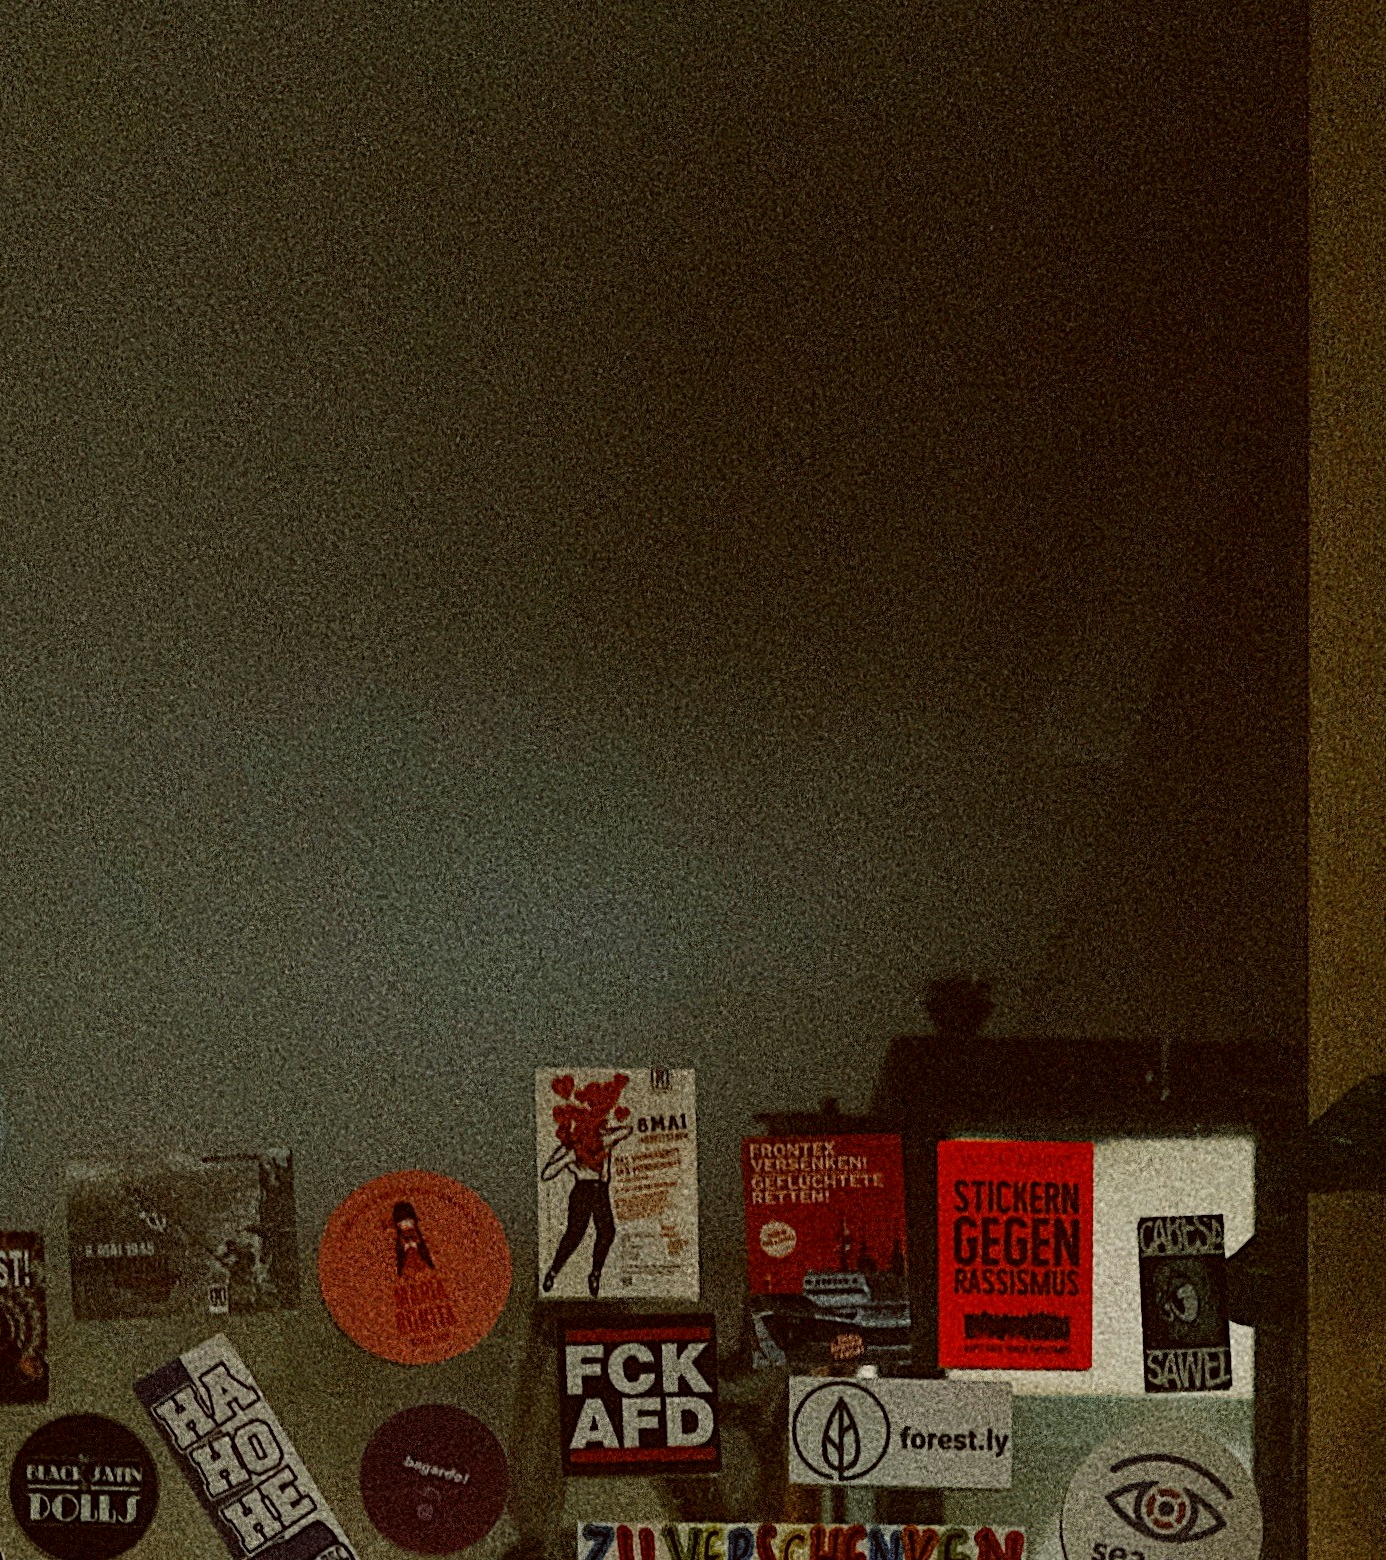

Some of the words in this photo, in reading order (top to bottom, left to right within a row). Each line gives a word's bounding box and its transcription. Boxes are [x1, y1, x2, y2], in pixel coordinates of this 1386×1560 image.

[749, 1142, 835, 1158] FRONTEX
[750, 1156, 867, 1171] VERSENKEN!
[751, 1190, 830, 1204] RETTEN!
[954, 1180, 1080, 1213] STICKERN
[953, 1216, 1080, 1266] GEGEN
[954, 1269, 1079, 1296] RASSISMUS
[565, 1342, 712, 1395] FCK
[569, 1396, 713, 1449] AFD
[900, 1427, 1008, 1457] forest.ly
[26, 1464, 80, 1481] BLACK
[26, 1493, 142, 1523] DOLLS
